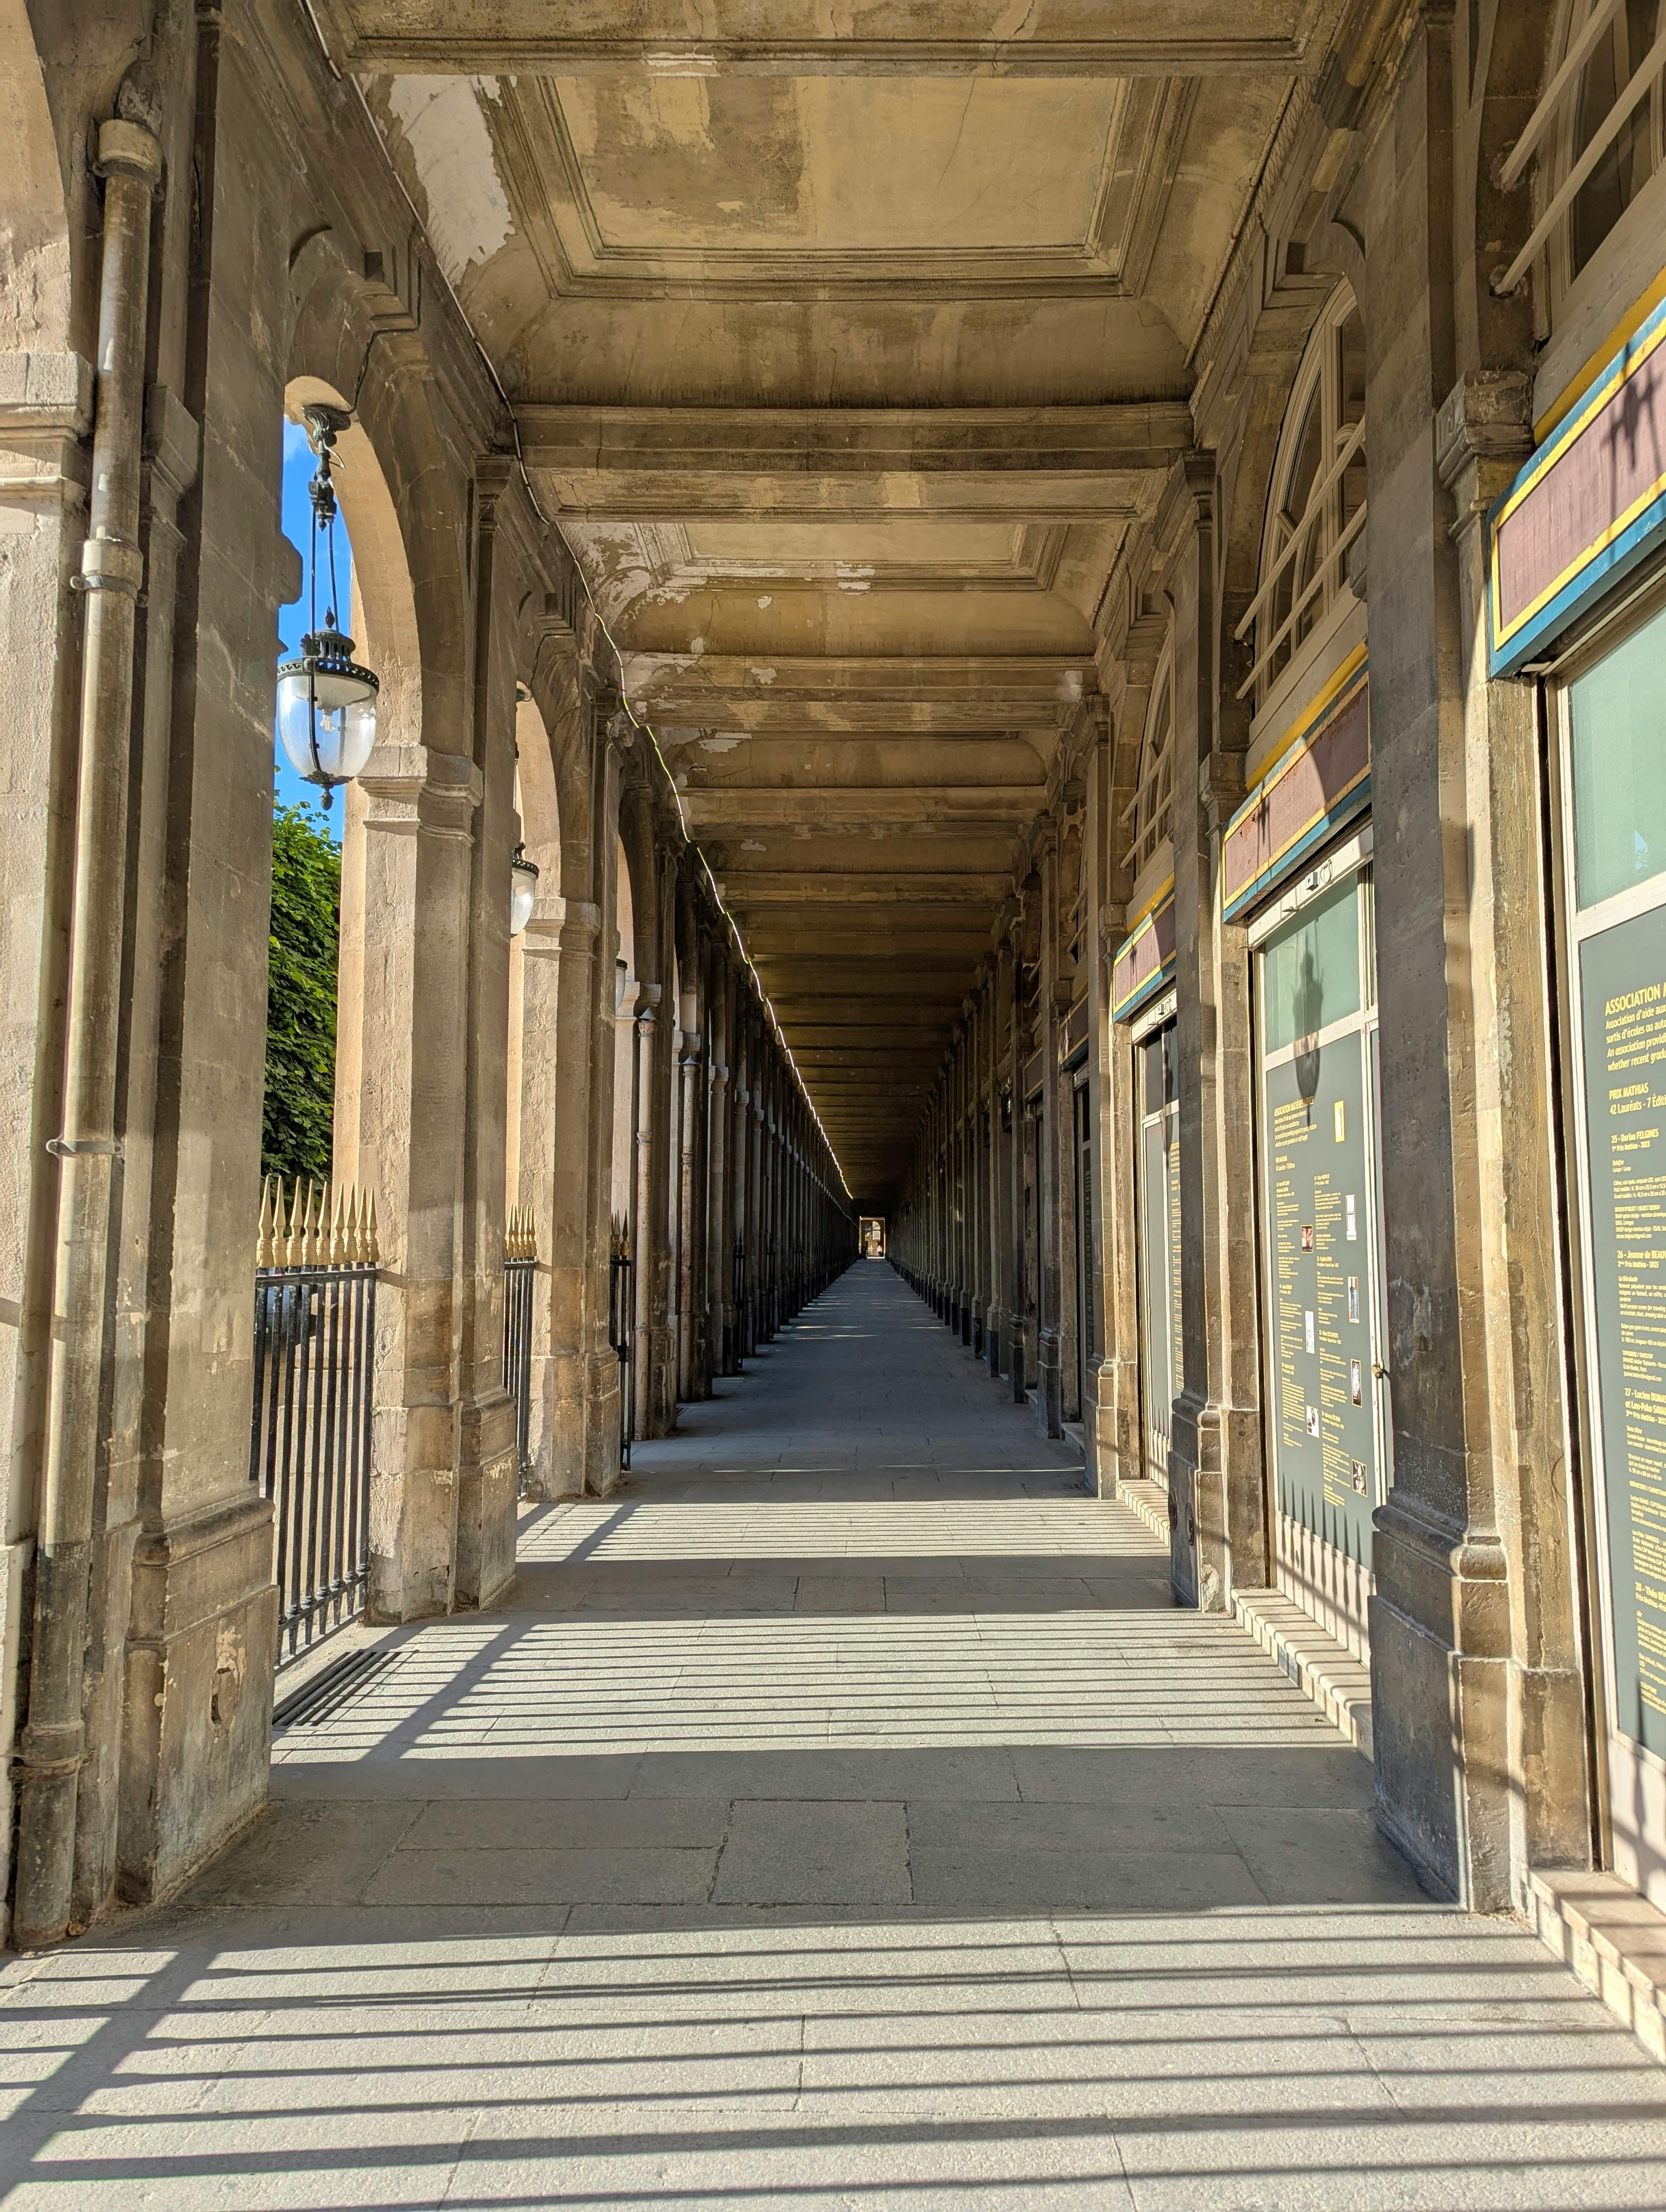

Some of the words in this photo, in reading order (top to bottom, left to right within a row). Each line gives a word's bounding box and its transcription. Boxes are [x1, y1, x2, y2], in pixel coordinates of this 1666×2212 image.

[1605, 983, 1661, 1016] ASSOCIATION
[1606, 1014, 1635, 1030] Association
[1636, 1006, 1655, 1020] d'aide
[1606, 1032, 1621, 1044] sortis
[1622, 1025, 1645, 1039] d'écoles
[1646, 1024, 1653, 1033] ou
[1607, 1048, 1614, 1058] An
[1615, 1040, 1645, 1056] association
[1608, 1059, 1630, 1072] whether
[1631, 1053, 1649, 1066] recent
[1609, 1088, 1622, 1101] PRIX
[1623, 1082, 1649, 1098] MATHIAS
[1610, 1104, 1617, 1115] 42
[1618, 1100, 1642, 1114] Lauréats
[1646, 1097, 1651, 1108] 7
[1611, 1135, 1617, 1143] 25
[1620, 1133, 1636, 1142] Dorian
[1617, 1250, 1623, 1259] 26
[1626, 1250, 1644, 1259] Jeanne
[1644, 1250, 1651, 1259] de
[1625, 1387, 1631, 1397] 27
[1634, 1390, 1650, 1400] Lucien
[1625, 1400, 1631, 1409] et
[1635, 1581, 1642, 1592] 28
